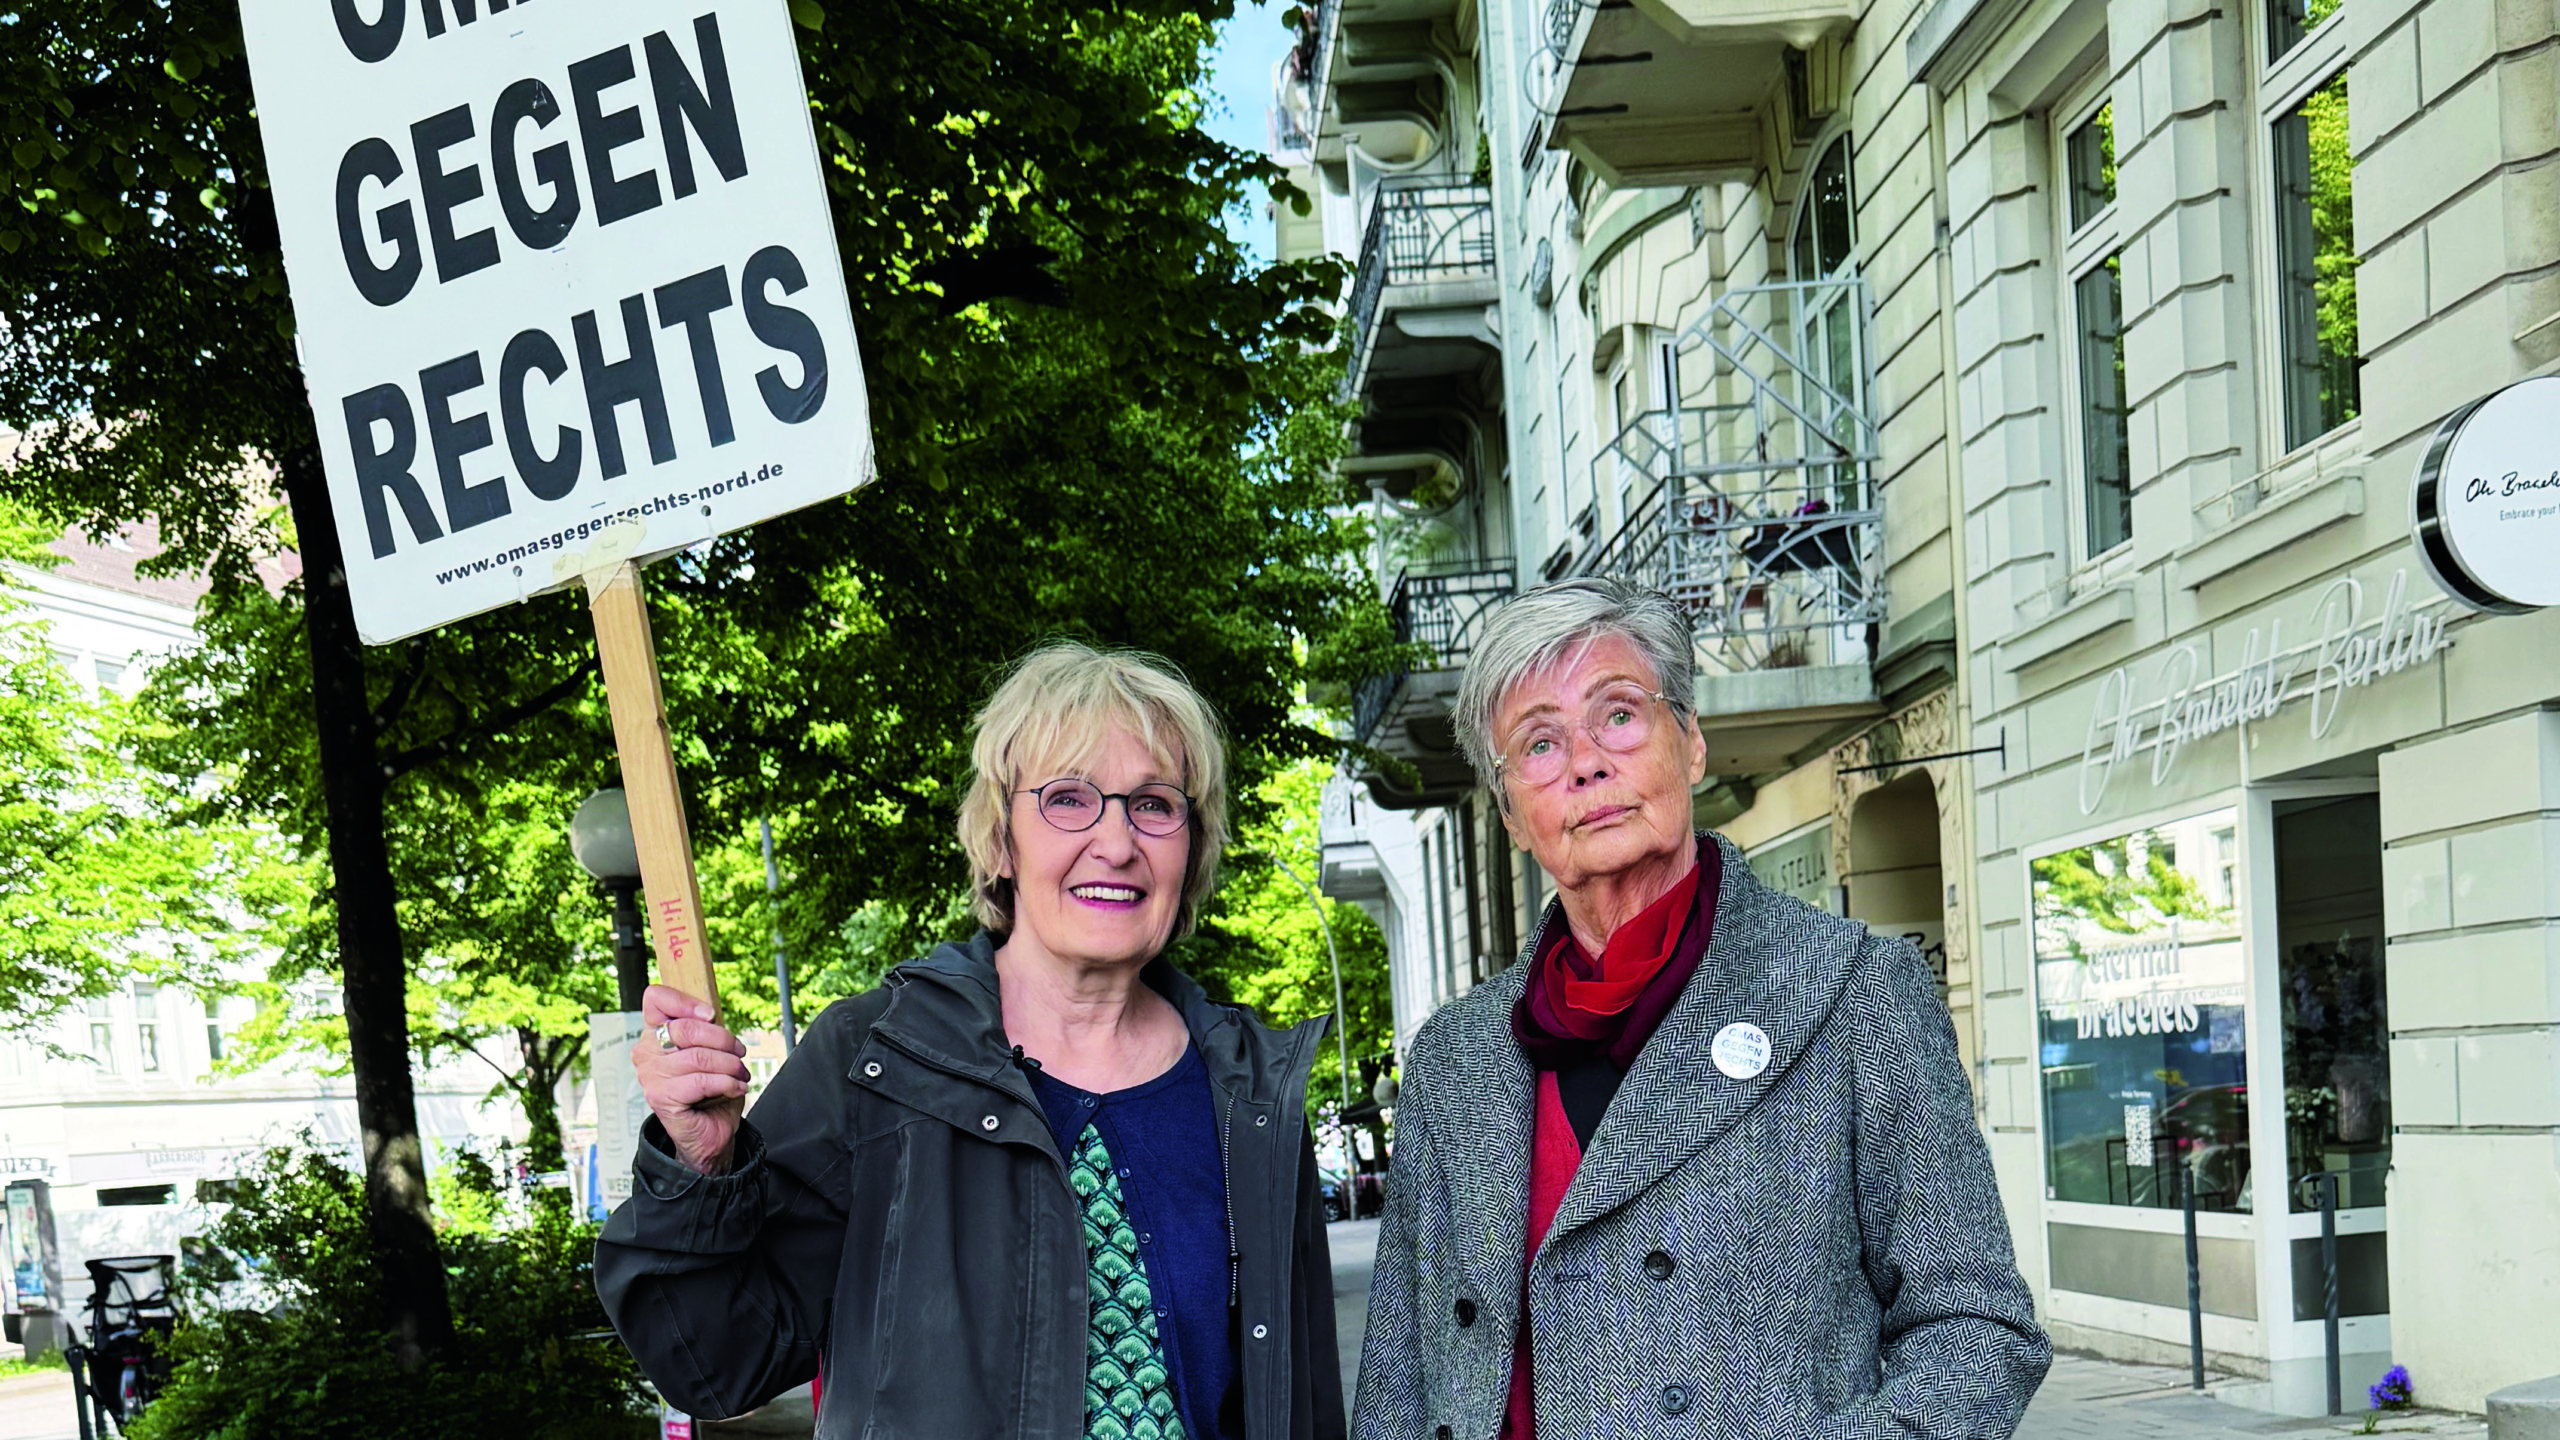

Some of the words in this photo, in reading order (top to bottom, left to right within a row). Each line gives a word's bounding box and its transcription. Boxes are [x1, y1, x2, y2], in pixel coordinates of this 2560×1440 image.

[336, 12, 748, 307] GEGEN
[342, 245, 828, 560] RECHTS
[2465, 478, 2496, 503] Oh
[2500, 508, 2535, 521] Embrace
[2538, 505, 2556, 519] your
[2080, 667, 2143, 815] Oh
[2152, 618, 2295, 786] Bracelet
[2310, 569, 2450, 739] Berlin
[1781, 850, 1827, 892] STELLA
[660, 898, 690, 962] Hilde
[2087, 922, 2181, 984] eternal
[2077, 981, 2199, 1039] bracelets
[1721, 1039, 1762, 1057] GEGEN
